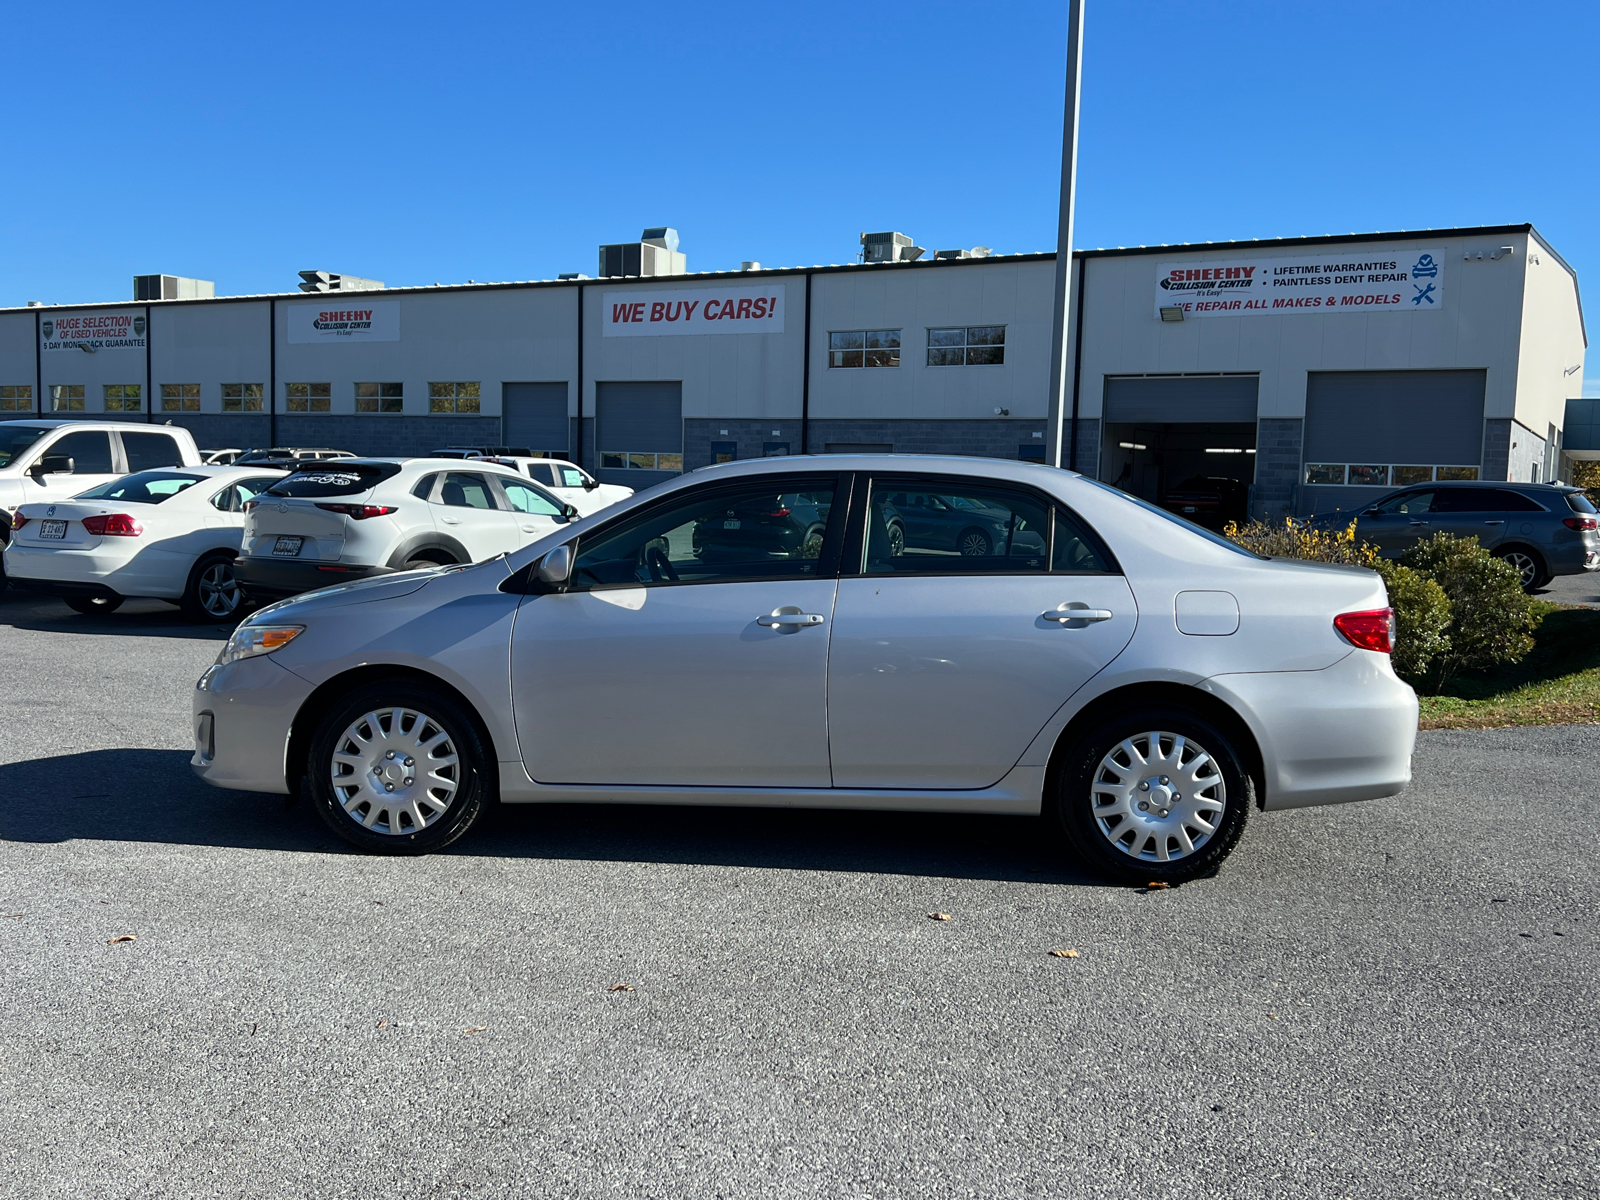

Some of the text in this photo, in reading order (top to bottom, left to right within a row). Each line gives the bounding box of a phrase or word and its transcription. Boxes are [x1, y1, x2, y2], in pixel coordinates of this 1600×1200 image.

[1170, 266, 1256, 281] SHEEHY
[1274, 261, 1397, 275] LIFETIME WARRANTIES
[1169, 279, 1253, 290] COLLISION CENTER
[1273, 272, 1408, 287] PAINTLESS DENT REPAIR
[1206, 289, 1223, 297] Easy!
[1195, 300, 1242, 311] REPAIR
[1243, 299, 1268, 309] ALL
[1272, 297, 1322, 308] MAKES
[1325, 296, 1336, 306] &
[1340, 293, 1401, 306] MODELS
[319, 310, 373, 322] SHEEHY
[612, 297, 777, 323] WE BUY CARS!
[56, 318, 80, 329] HUGE
[82, 316, 132, 328] SELECTION
[319, 322, 348, 330] COLLISION
[60, 328, 128, 339] OF USED VEHICLES
[43, 342, 48, 350] 5
[105, 339, 145, 348] GUARANTEE
